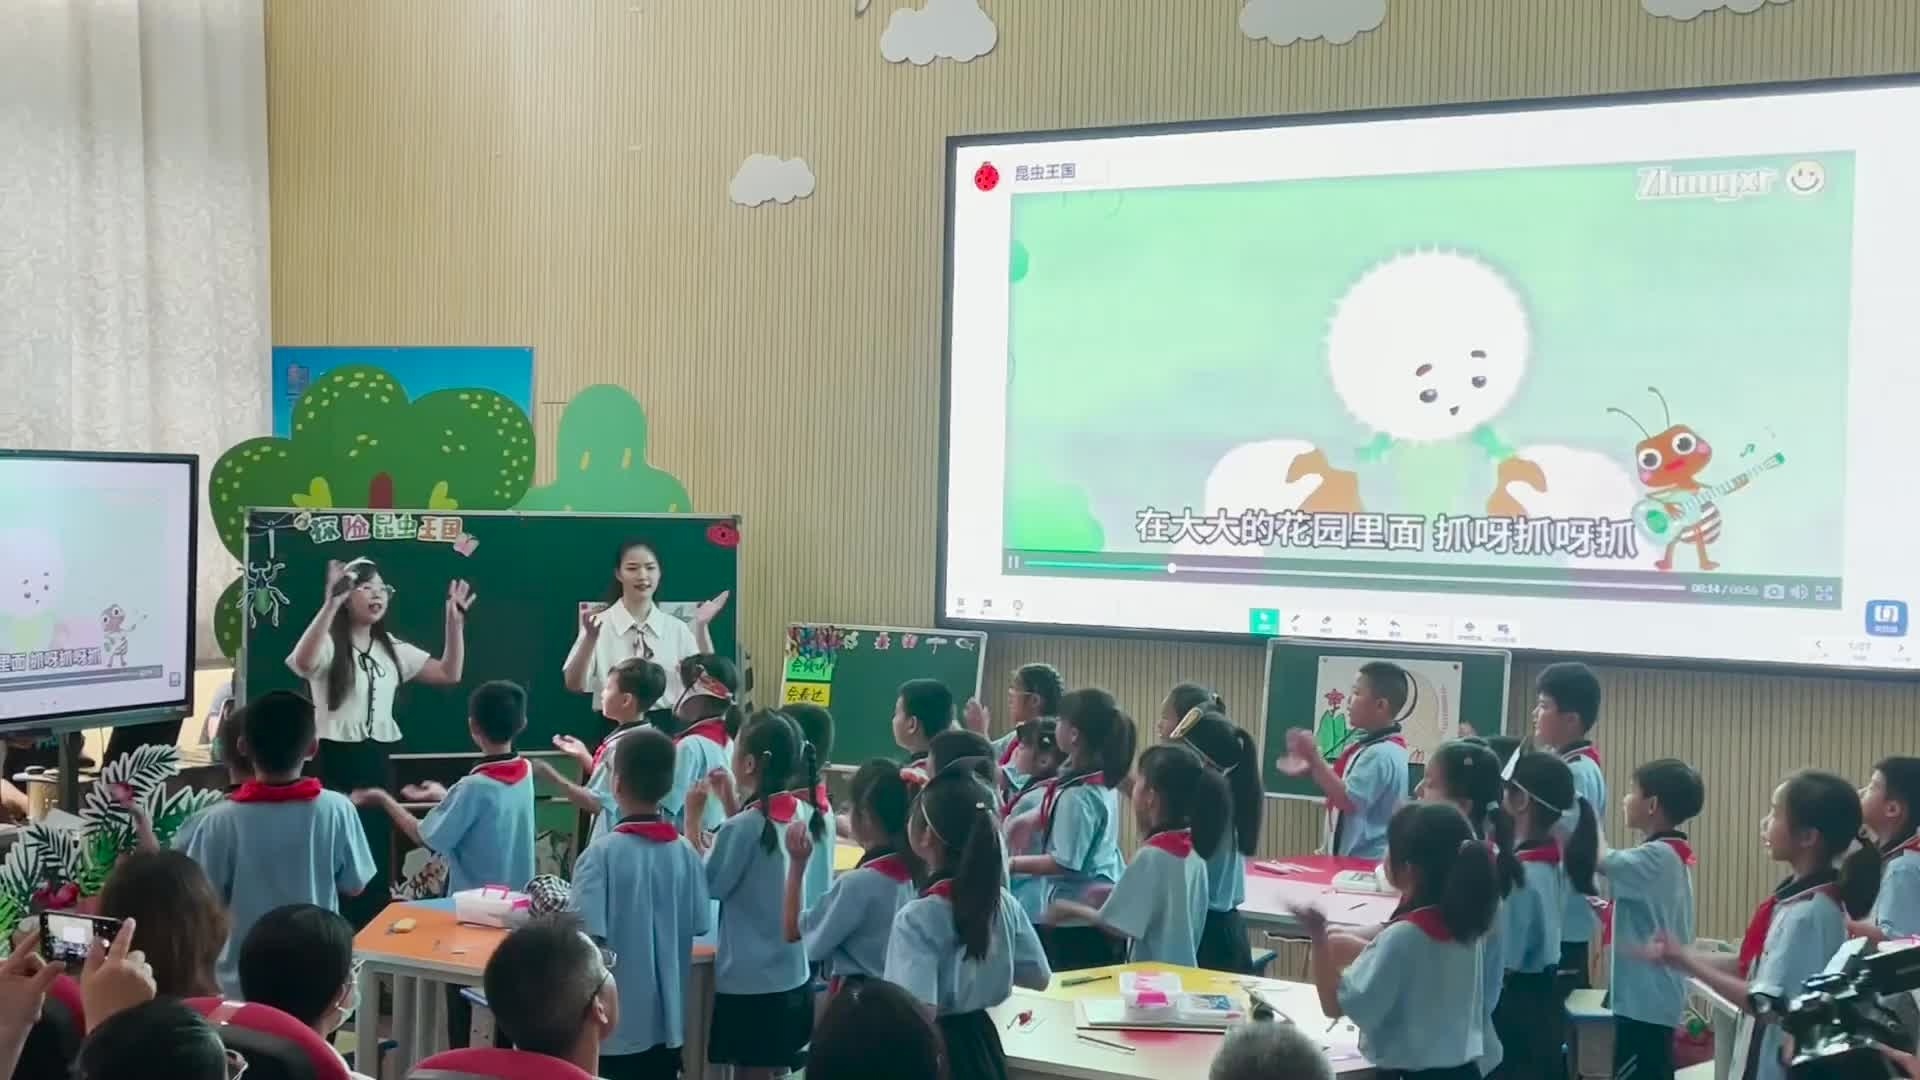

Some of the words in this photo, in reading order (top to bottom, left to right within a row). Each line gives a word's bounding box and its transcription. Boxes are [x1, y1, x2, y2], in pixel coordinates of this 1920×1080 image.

[1015, 163, 1077, 182] 昆虫王国
[309, 512, 463, 544] 探险昆虫王国
[1135, 507, 1425, 552] 在大大的花园里面
[1433, 513, 1638, 559] 抓呀抓呀抓
[29, 647, 102, 671] 抓呀抓呀抓
